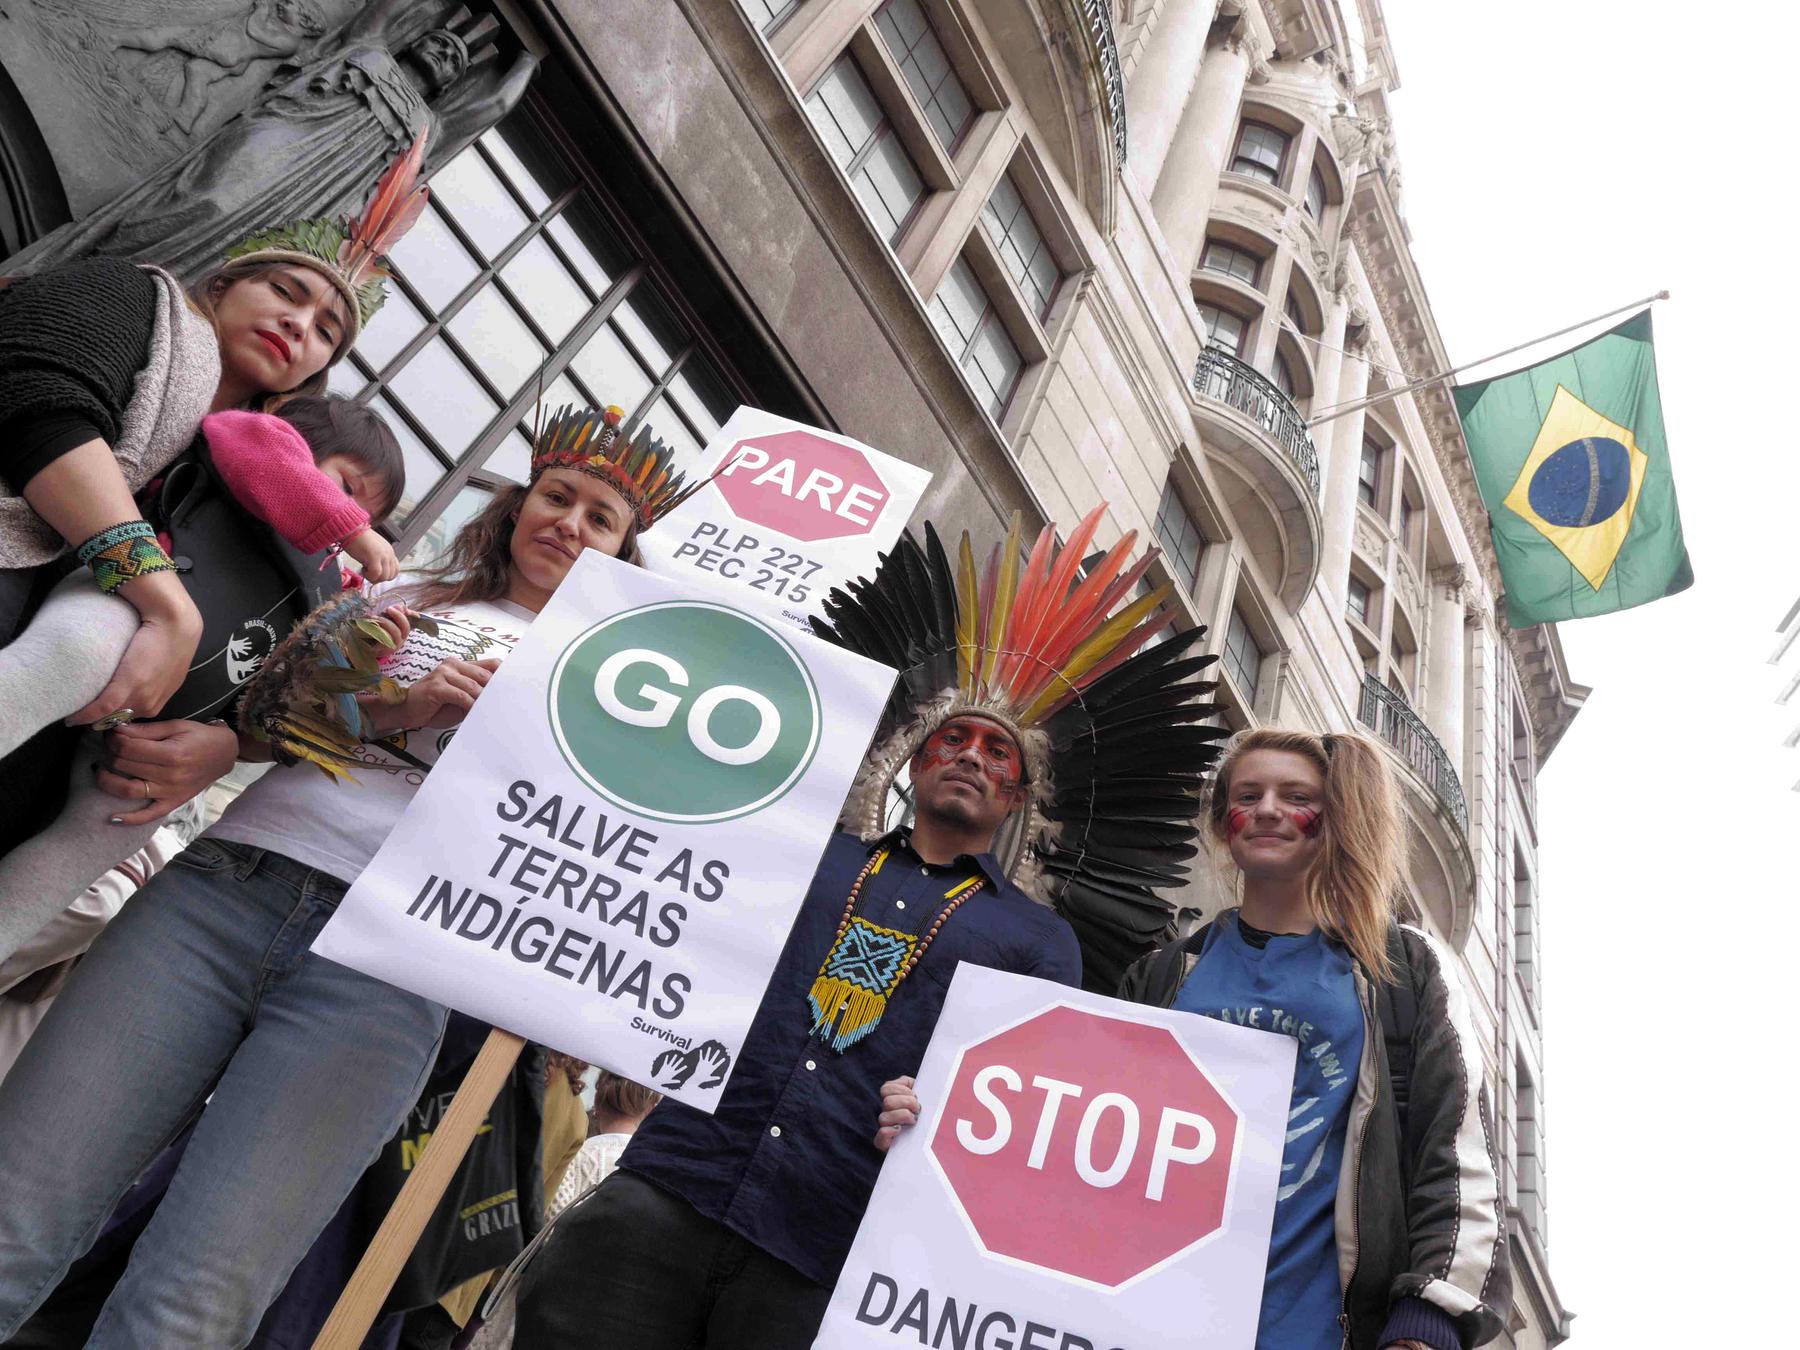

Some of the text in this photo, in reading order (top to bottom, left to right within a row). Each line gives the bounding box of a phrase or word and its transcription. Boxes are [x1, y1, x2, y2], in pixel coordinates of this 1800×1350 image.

[722, 445, 882, 527] PARE
[672, 542, 811, 602] PEC 215
[691, 522, 823, 580] PLP 227
[594, 648, 781, 765] GO
[497, 780, 730, 902] SALVE AS
[487, 833, 688, 948] TERRAS
[406, 875, 692, 1020] INDÍGENAS
[630, 1016, 692, 1050] Survival
[1271, 1009, 1313, 1043] THE
[956, 1065, 1216, 1202] STOP
